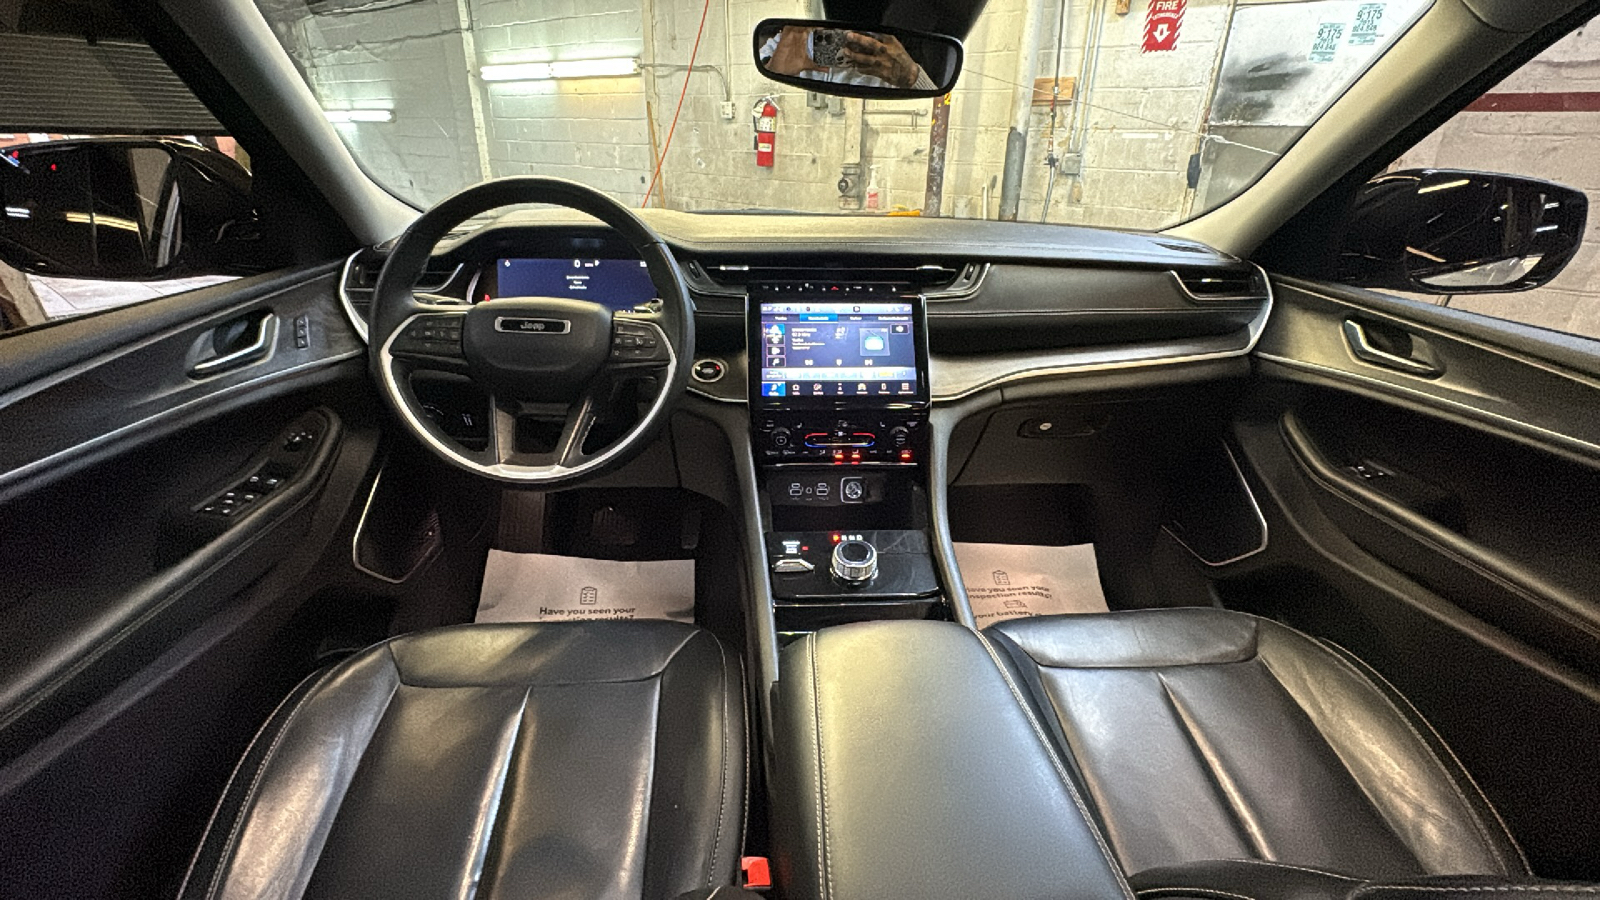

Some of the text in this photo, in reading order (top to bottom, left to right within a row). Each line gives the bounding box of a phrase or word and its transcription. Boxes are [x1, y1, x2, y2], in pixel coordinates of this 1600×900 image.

[1156, 1, 1179, 11] FIRE
[520, 321, 546, 331] Jeep
[539, 606, 565, 616] Have
[566, 608, 586, 617] you
[613, 607, 636, 616] your
